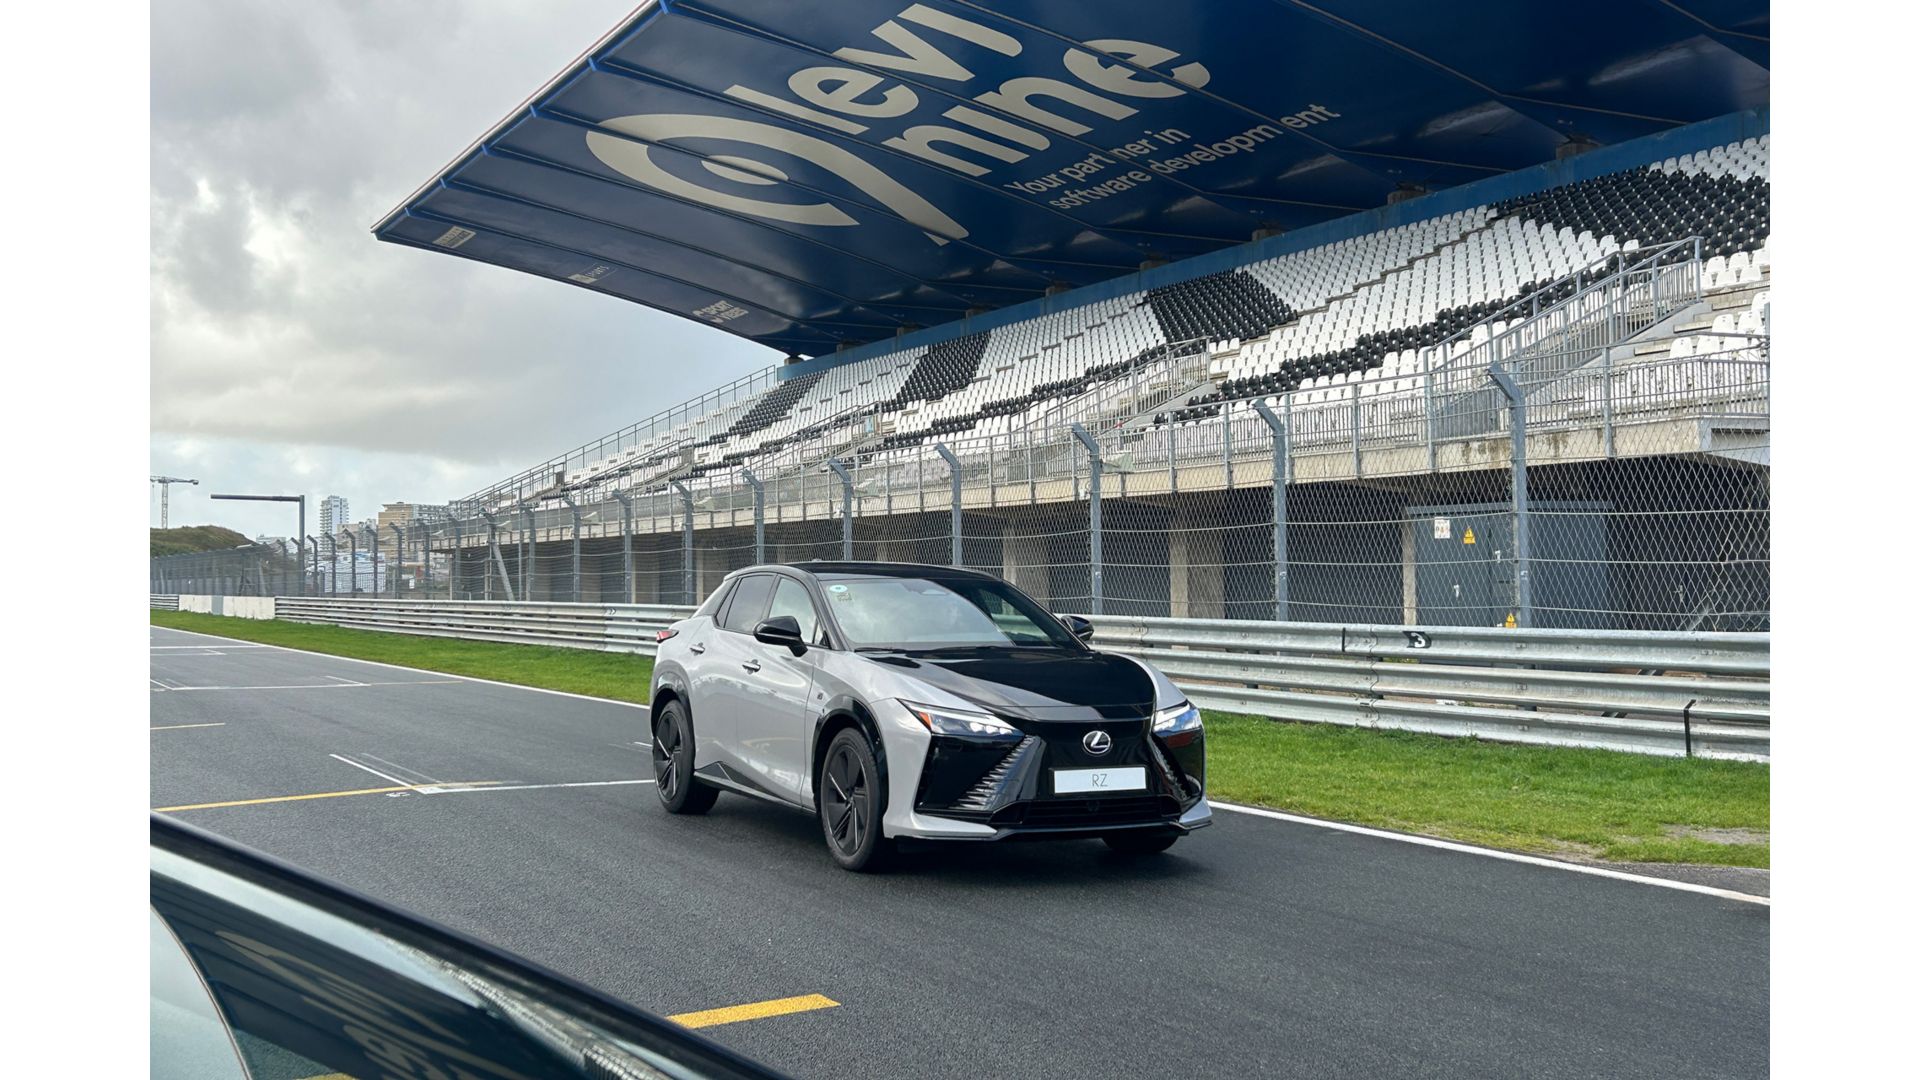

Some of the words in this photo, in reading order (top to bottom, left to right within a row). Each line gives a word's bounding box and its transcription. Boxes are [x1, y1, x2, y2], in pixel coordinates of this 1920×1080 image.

[881, 39, 1211, 177] nine
[1004, 173, 1067, 195] Your
[1145, 126, 1191, 145] in
[1048, 168, 1152, 210] software
[1150, 103, 1341, 175] development
[1411, 632, 1426, 648] 3
[1091, 773, 1108, 788] RZ
